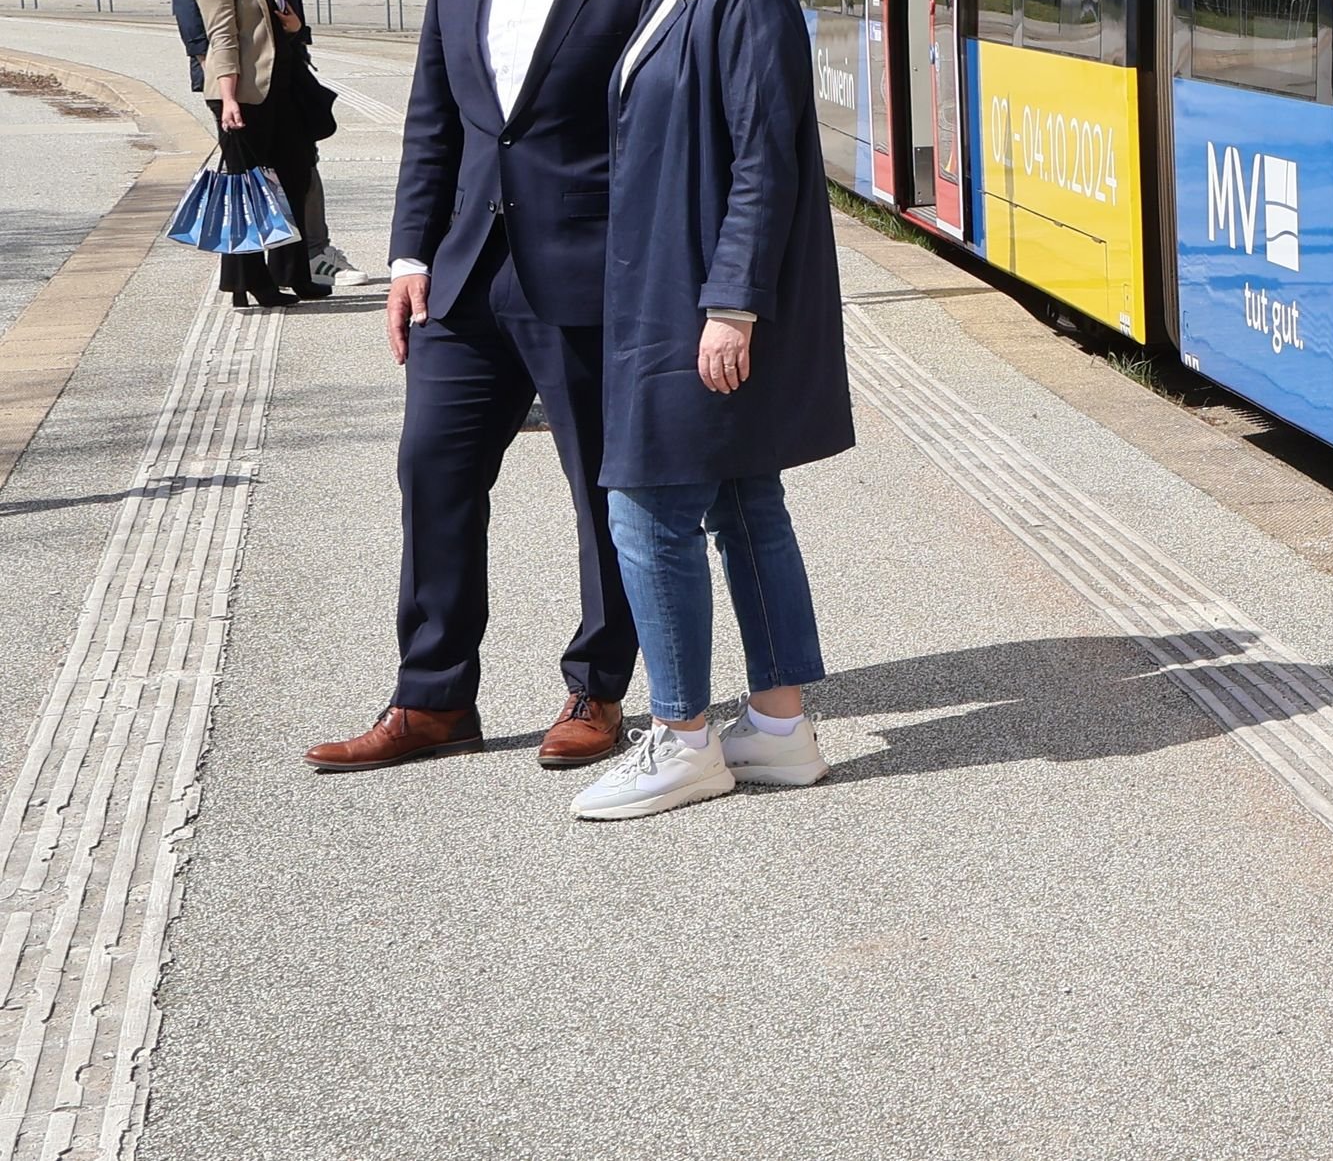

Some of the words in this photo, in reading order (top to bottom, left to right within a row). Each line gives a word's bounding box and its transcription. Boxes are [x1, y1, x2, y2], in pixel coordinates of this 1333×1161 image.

[817, 47, 856, 111] Schwerin
[1206, 140, 1262, 256] MV
[1244, 281, 1269, 333] tut
[1271, 300, 1304, 354] gut.
